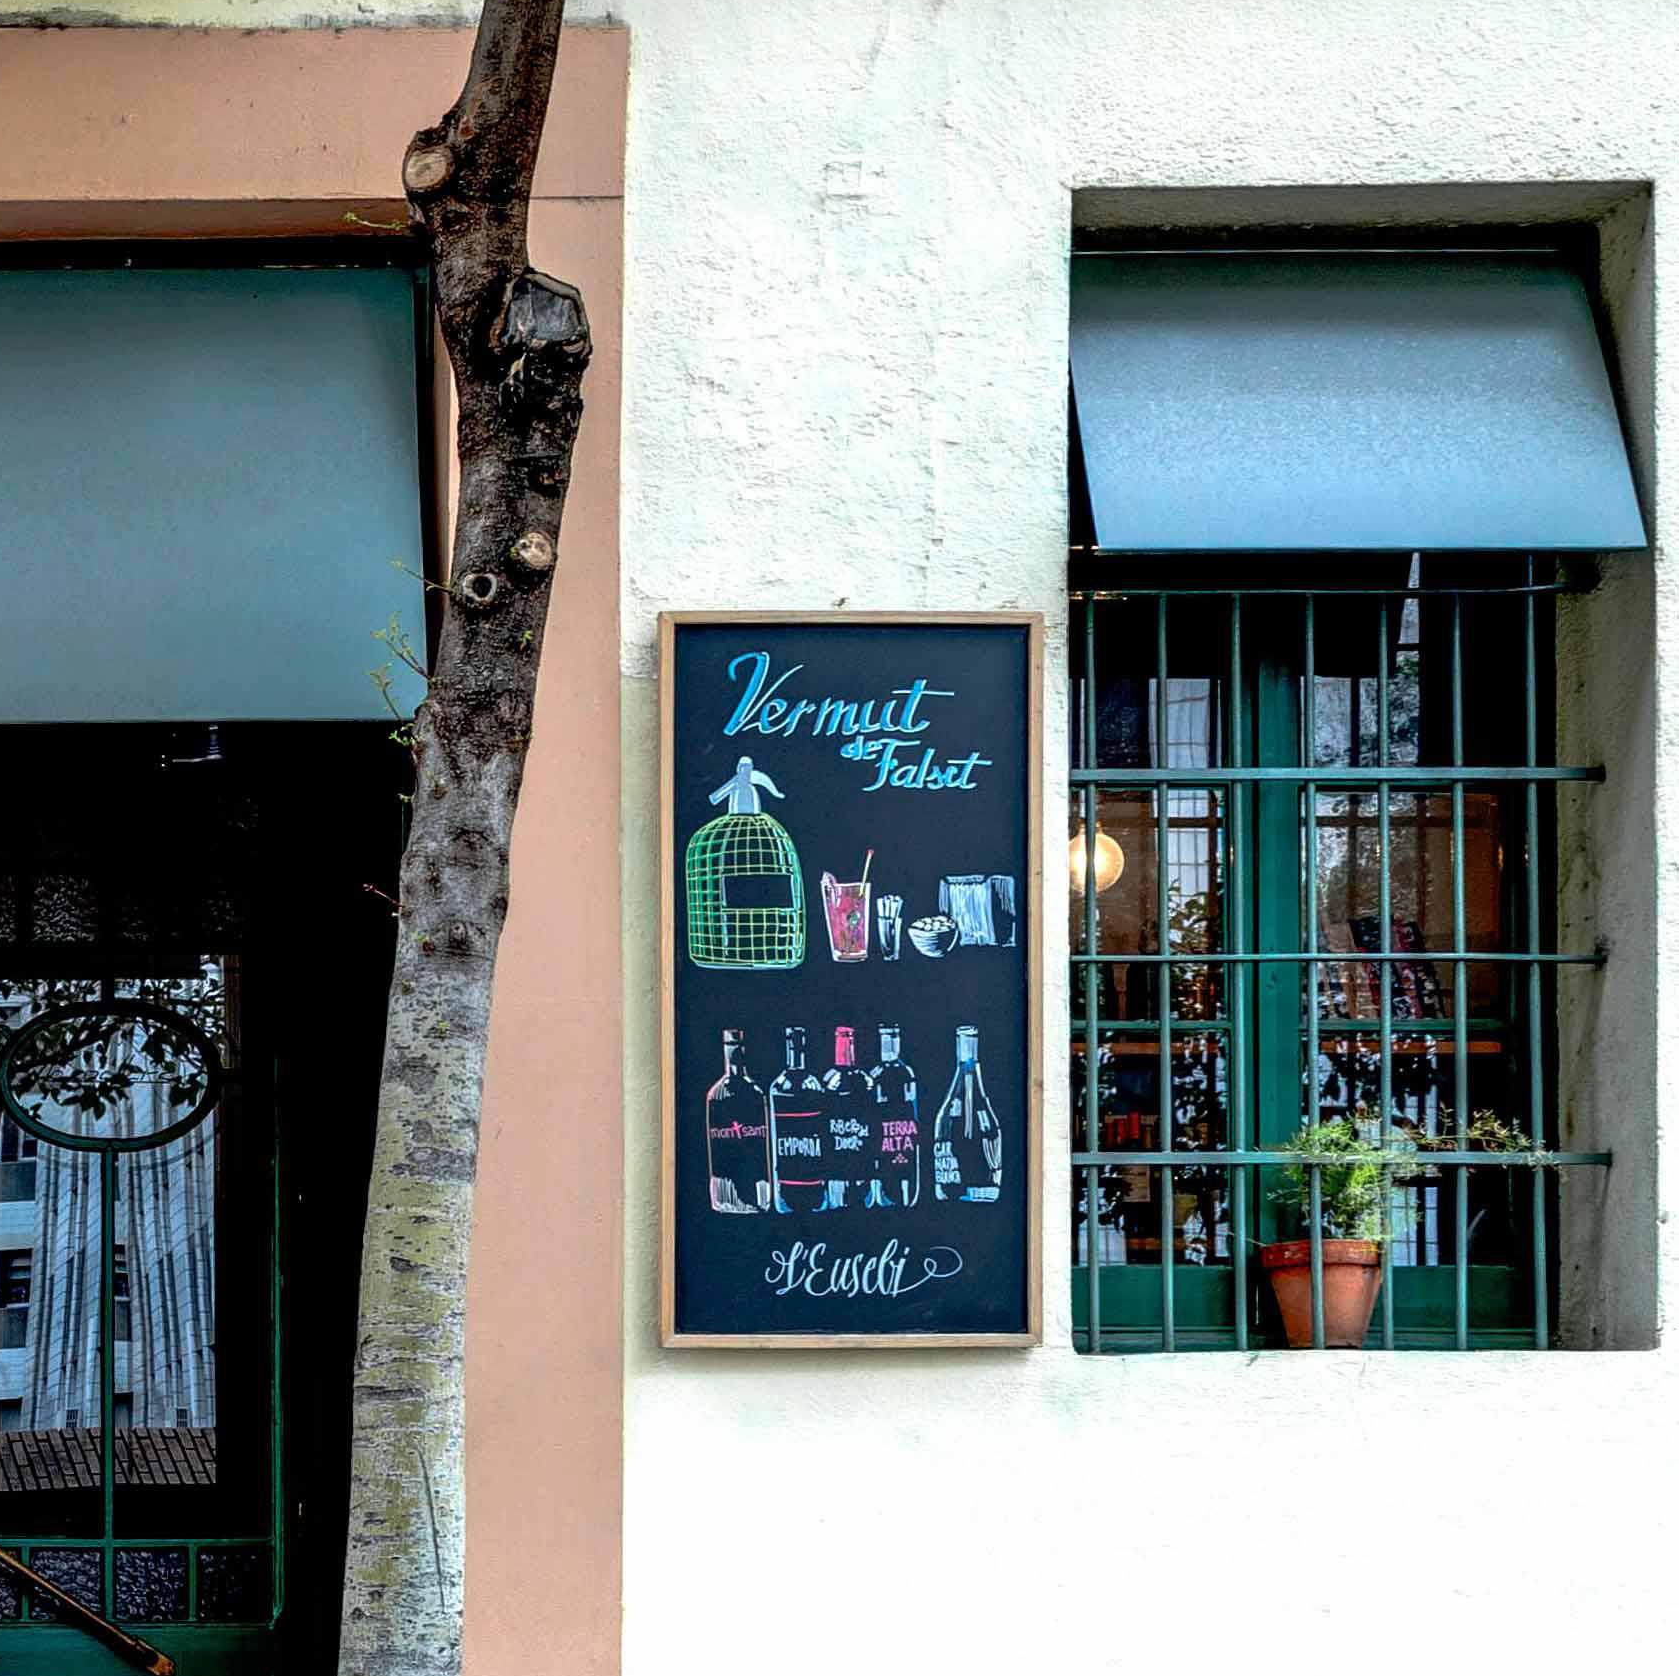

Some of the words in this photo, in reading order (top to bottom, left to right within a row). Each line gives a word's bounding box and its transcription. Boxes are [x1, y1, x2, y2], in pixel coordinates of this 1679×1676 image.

[723, 651, 955, 738] Vermut
[840, 735, 880, 762] de
[862, 739, 993, 792] Falset
[881, 1120, 918, 1136] TERRA
[881, 1136, 914, 1151] ALTA
[764, 1238, 963, 1298] L'Eusebi
